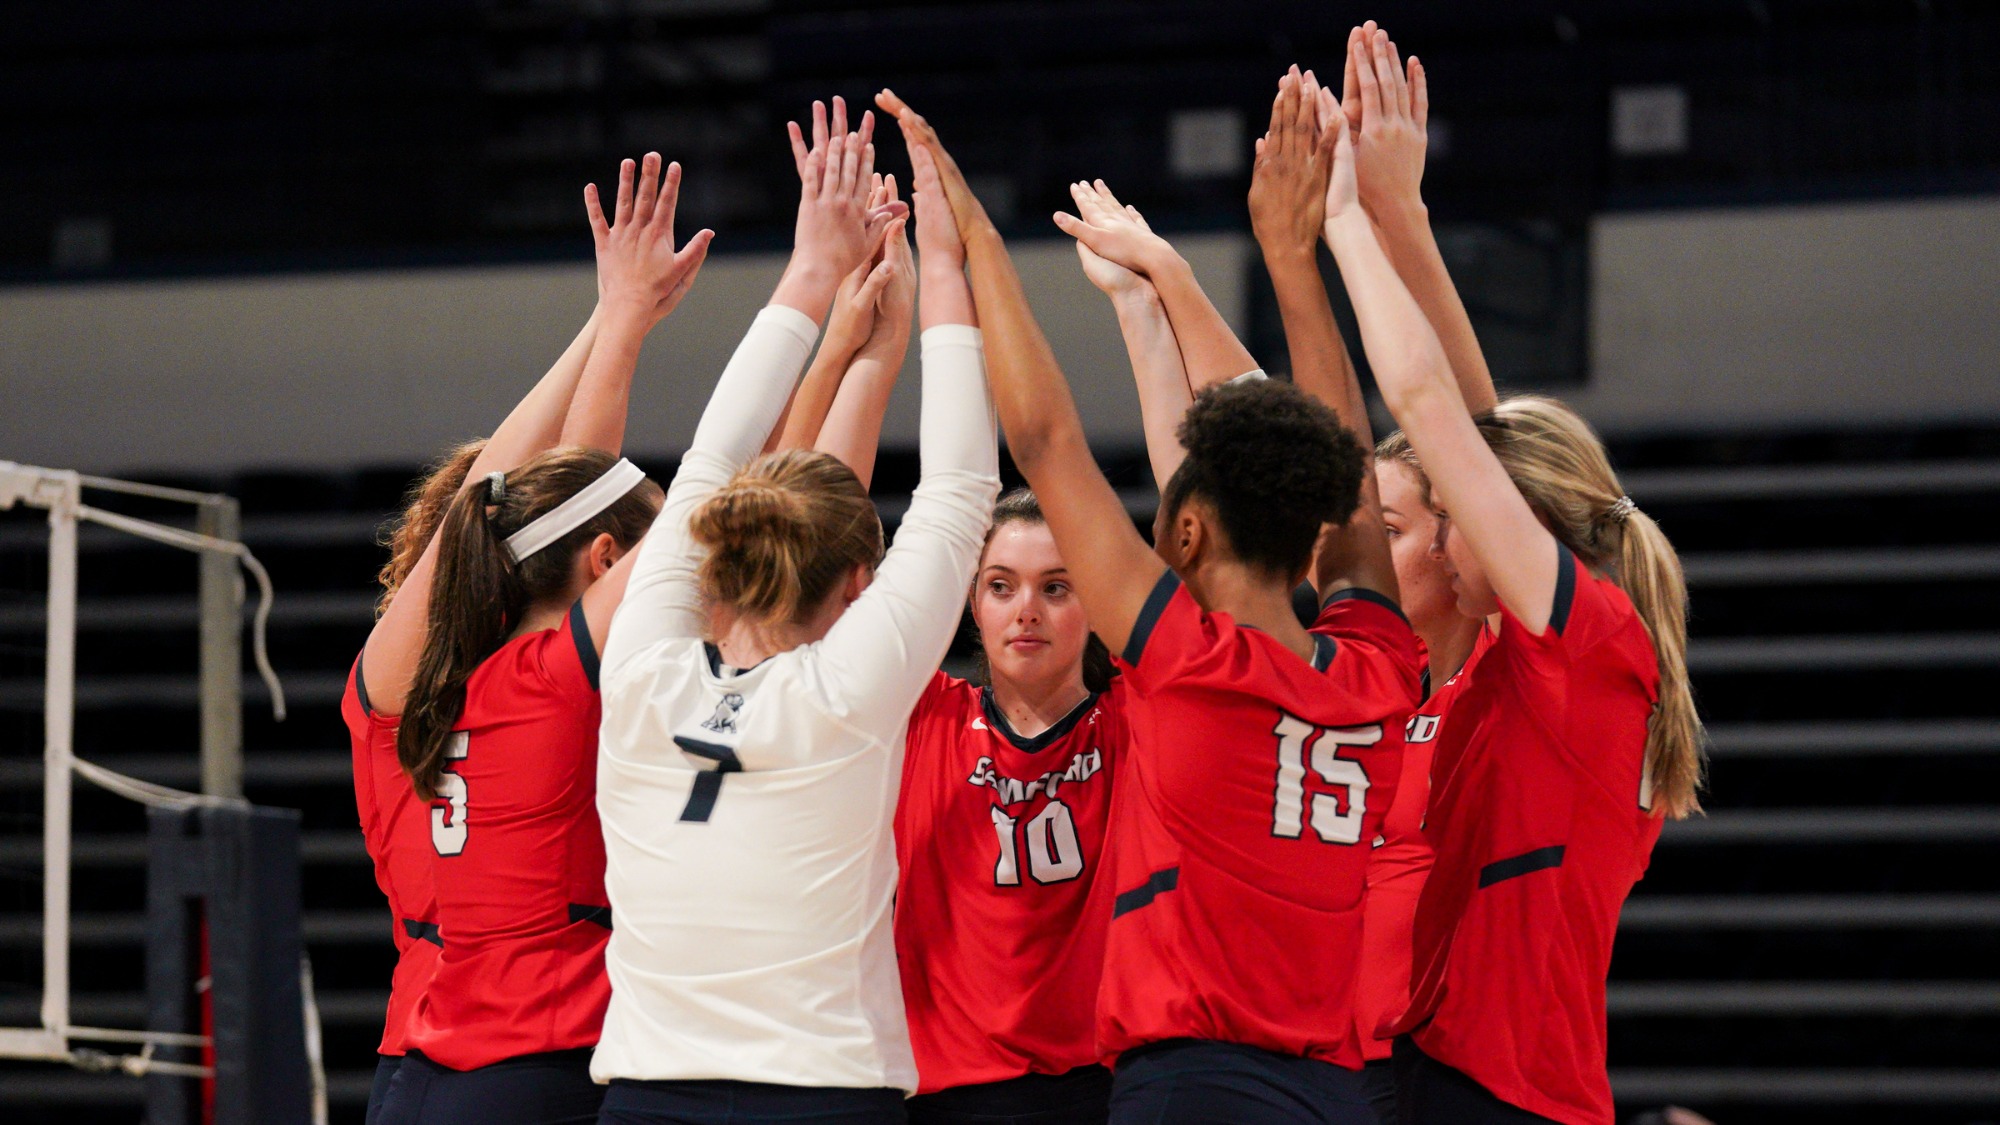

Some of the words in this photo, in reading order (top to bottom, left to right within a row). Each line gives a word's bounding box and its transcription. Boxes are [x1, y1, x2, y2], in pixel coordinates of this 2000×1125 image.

[430, 729, 470, 858] 5
[673, 734, 743, 823] 7
[1270, 707, 1384, 846] 15
[990, 798, 1085, 887] 10
